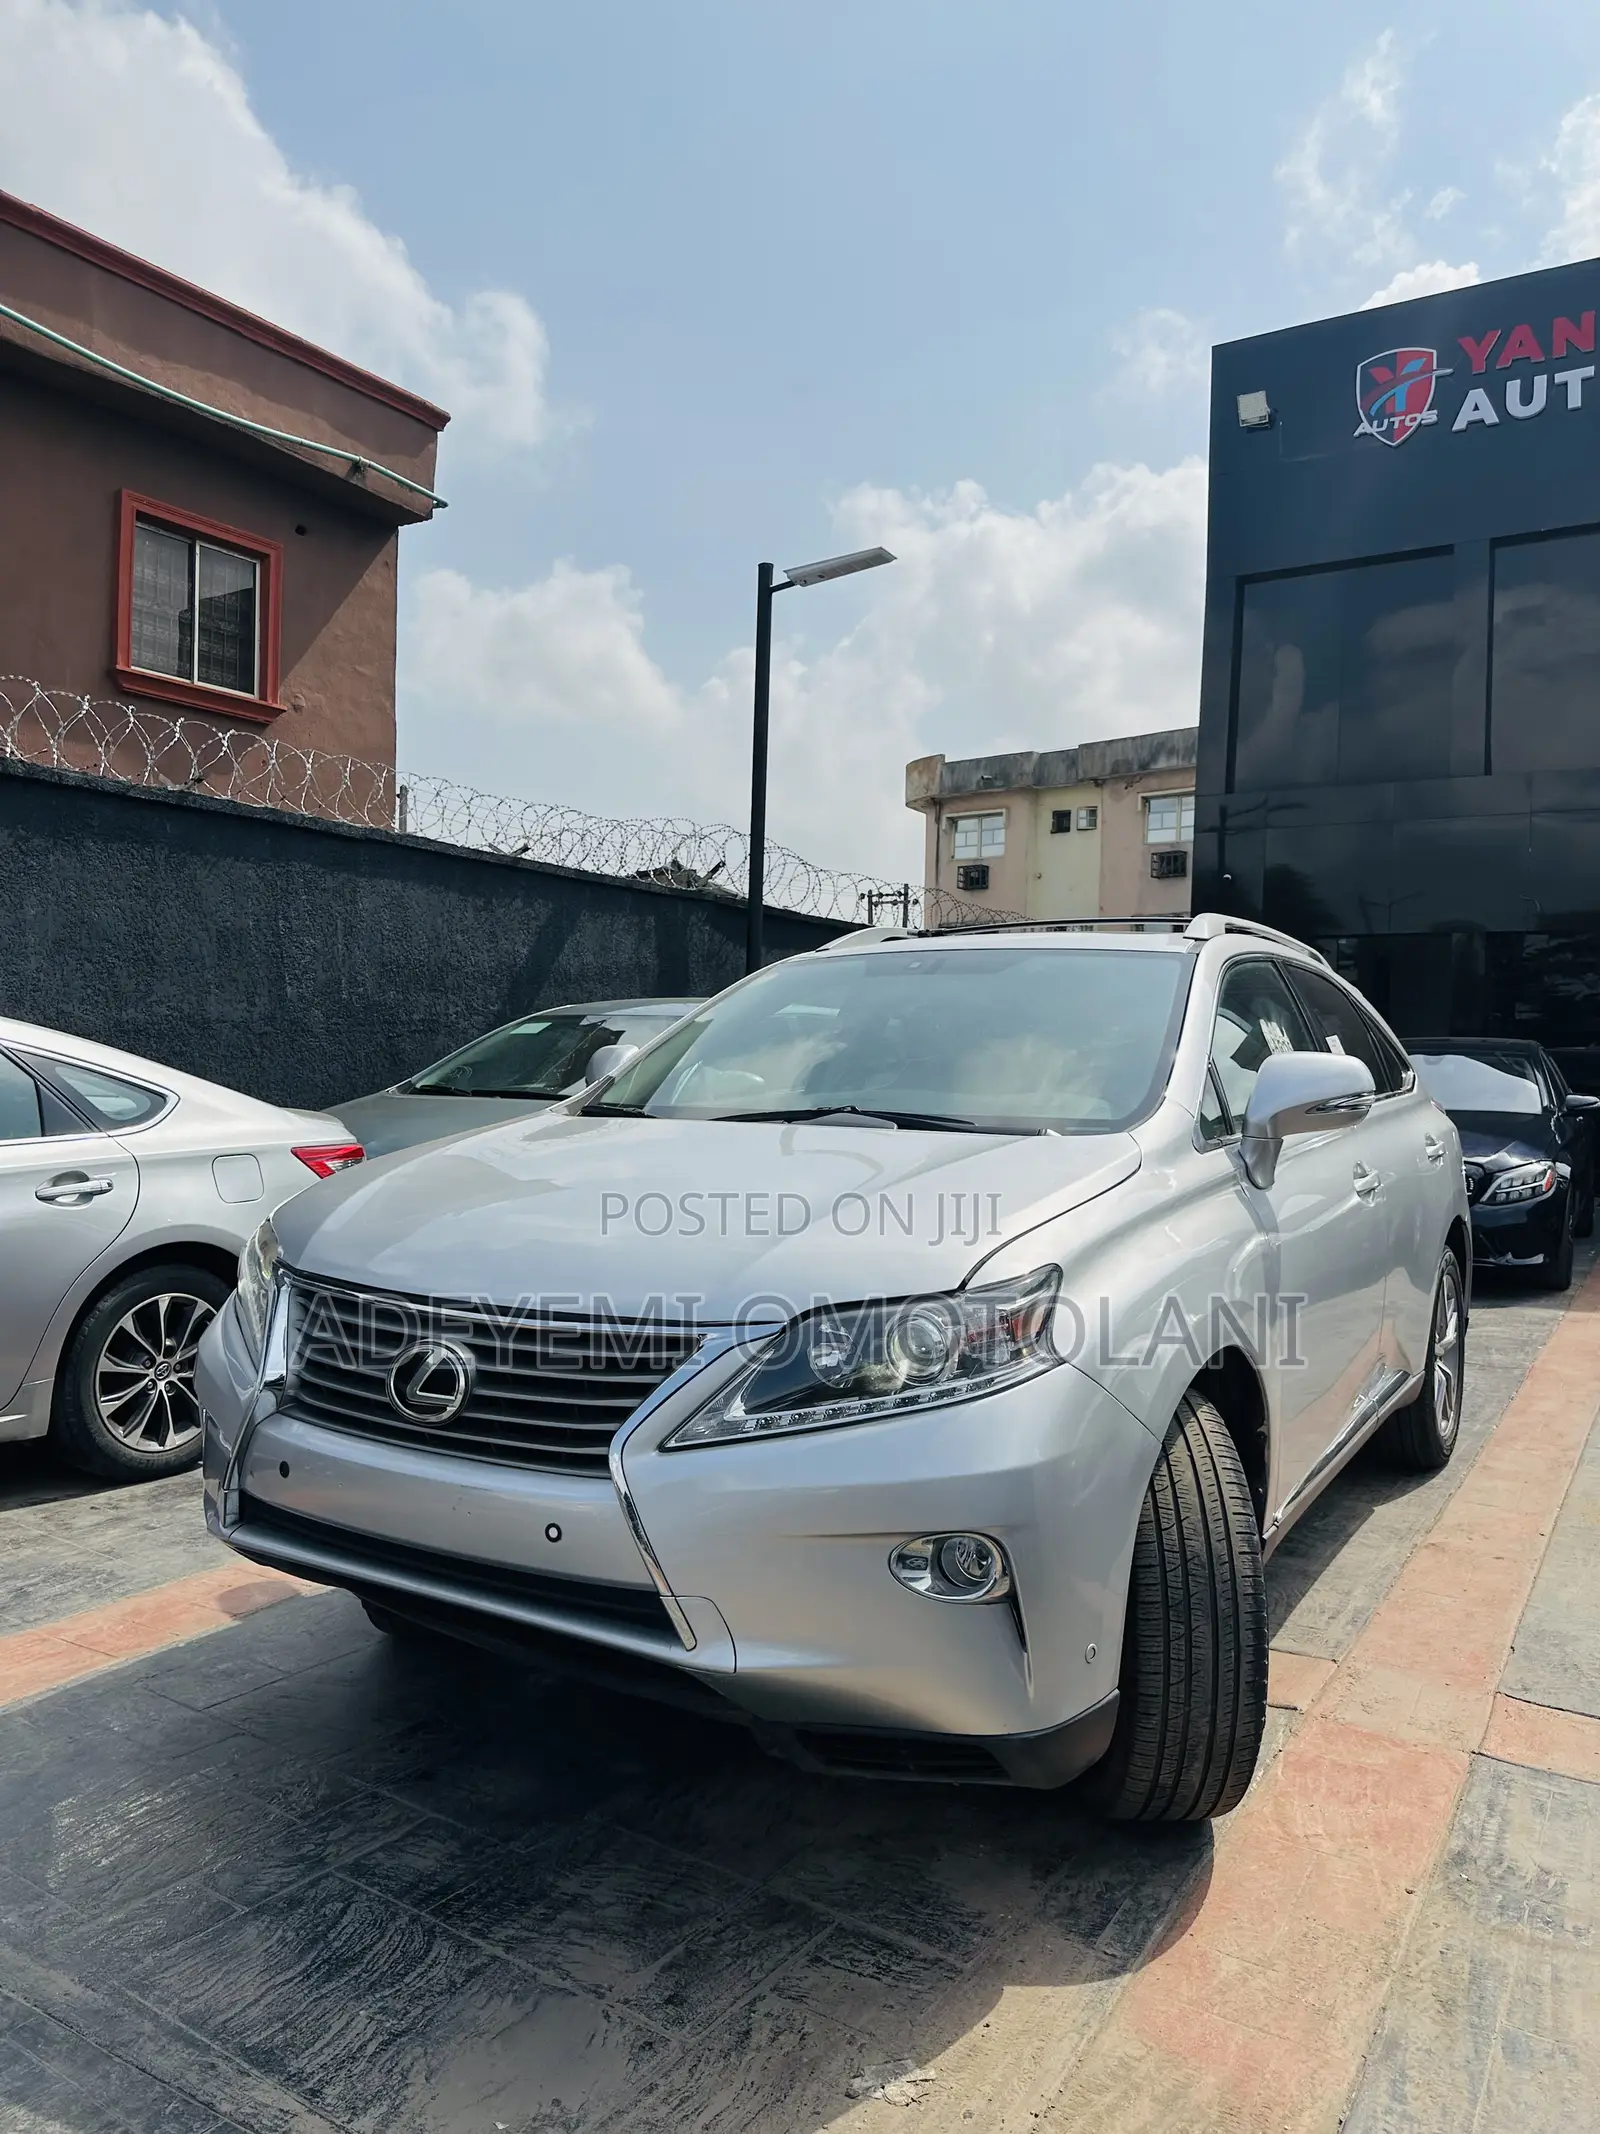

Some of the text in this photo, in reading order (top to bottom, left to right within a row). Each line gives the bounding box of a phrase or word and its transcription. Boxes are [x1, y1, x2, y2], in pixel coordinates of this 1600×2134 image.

[1457, 310, 1596, 374] YAN
[1353, 409, 1438, 437] AUTOS
[1452, 365, 1595, 432] AUT
